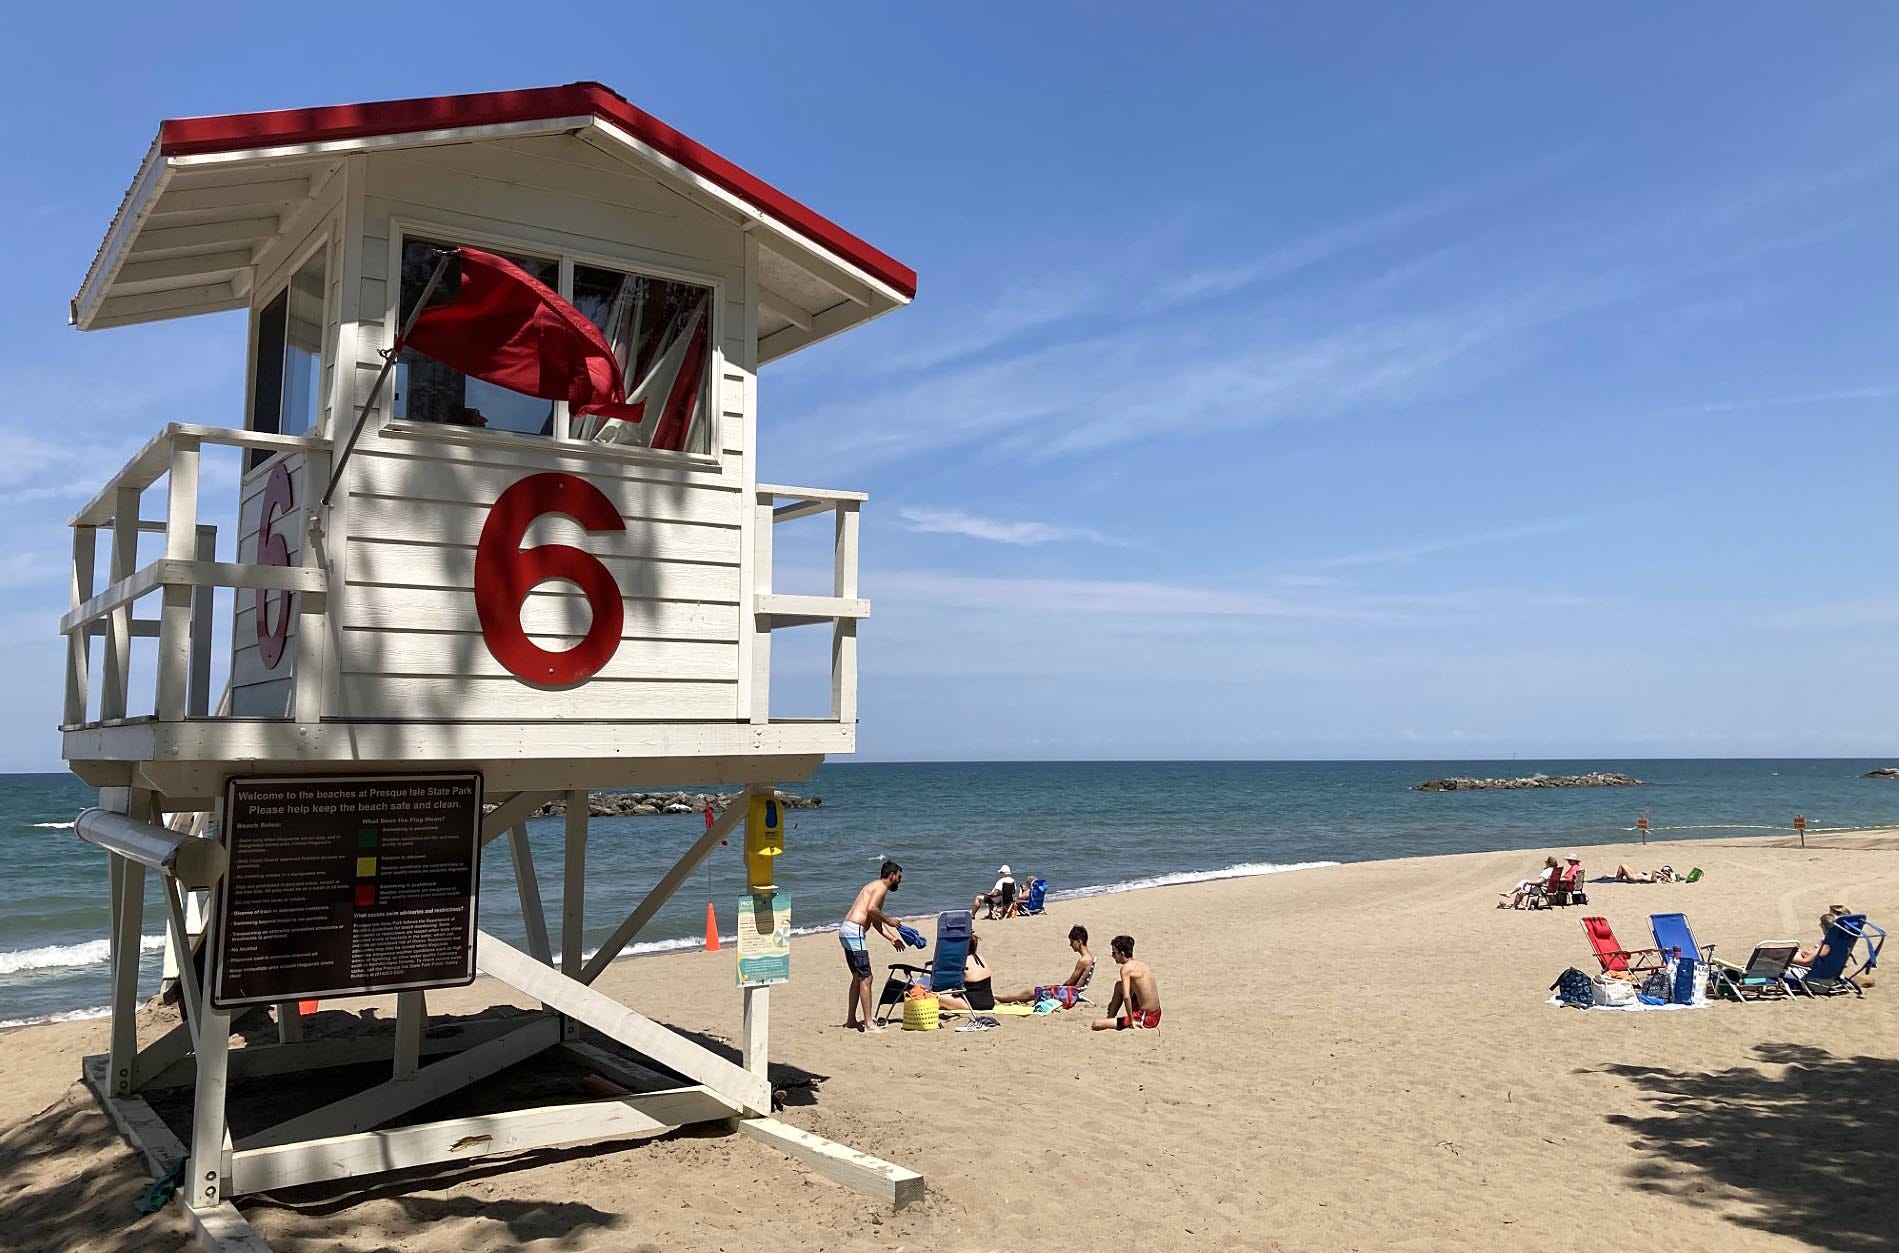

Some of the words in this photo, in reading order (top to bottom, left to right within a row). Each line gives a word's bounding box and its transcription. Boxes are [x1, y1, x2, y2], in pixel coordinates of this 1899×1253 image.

[256, 462, 293, 670] 6
[474, 472, 626, 687] 6
[238, 791, 285, 801] Welcome
[286, 791, 297, 800] to
[299, 790, 314, 799] the
[316, 789, 356, 799] beaches
[358, 789, 368, 798] at
[370, 787, 406, 798] Presque
[409, 788, 425, 796] Isle
[428, 787, 450, 796] State
[452, 786, 473, 795] Park
[248, 805, 285, 815] Please
[287, 804, 310, 815] help
[312, 803, 337, 814] keep
[340, 803, 355, 812] the
[358, 801, 388, 811] beach
[390, 801, 411, 810] safe
[413, 800, 430, 809] and
[433, 800, 461, 809] clean.
